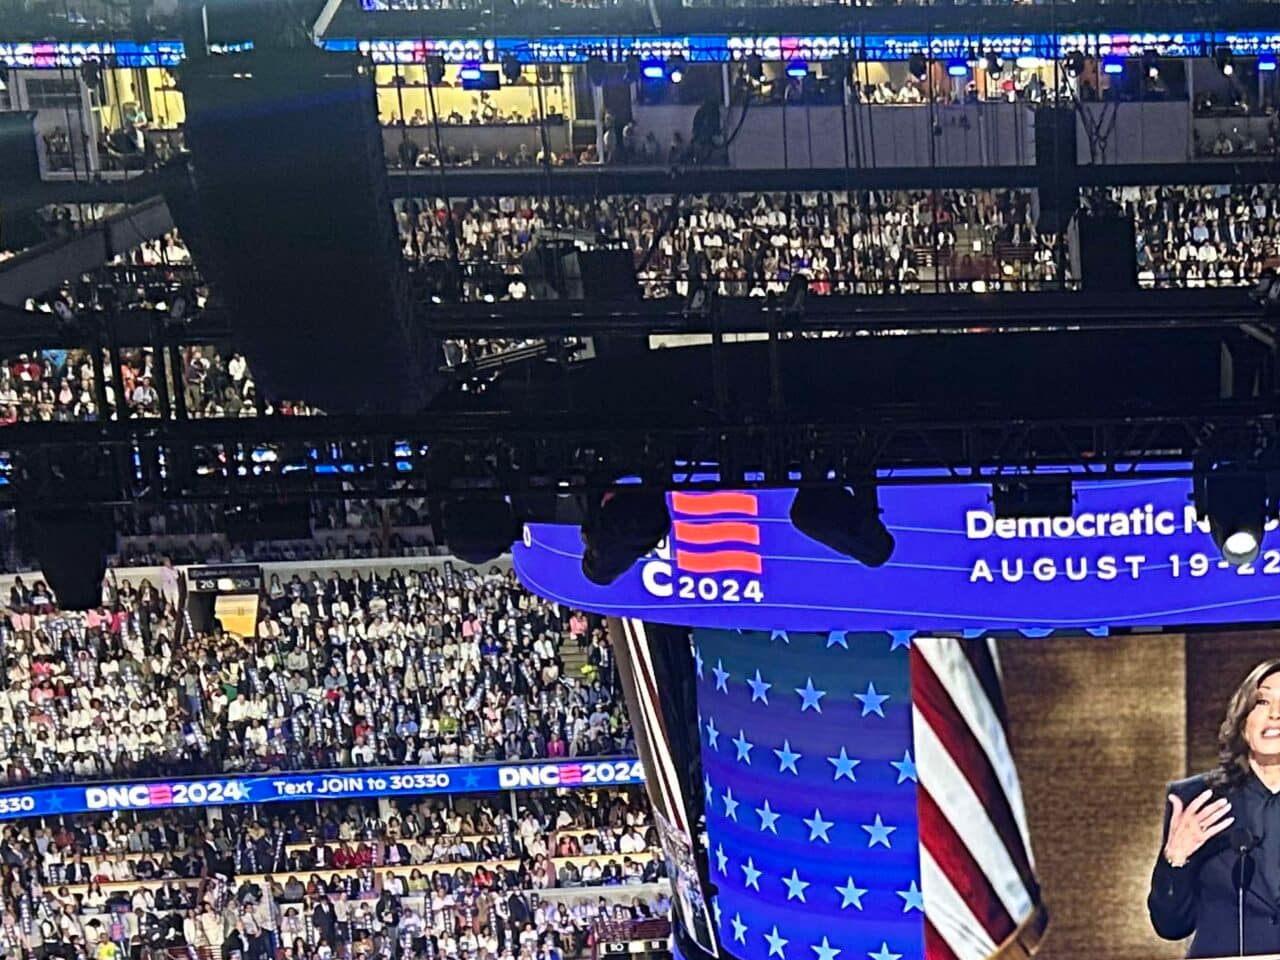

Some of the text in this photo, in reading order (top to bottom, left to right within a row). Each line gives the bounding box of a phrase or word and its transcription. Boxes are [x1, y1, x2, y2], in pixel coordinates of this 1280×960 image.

[965, 503, 1176, 540] Democratic
[969, 554, 1147, 583] AUGUST
[678, 576, 765, 603] 2024
[273, 773, 451, 796] Text JOIN to 30330
